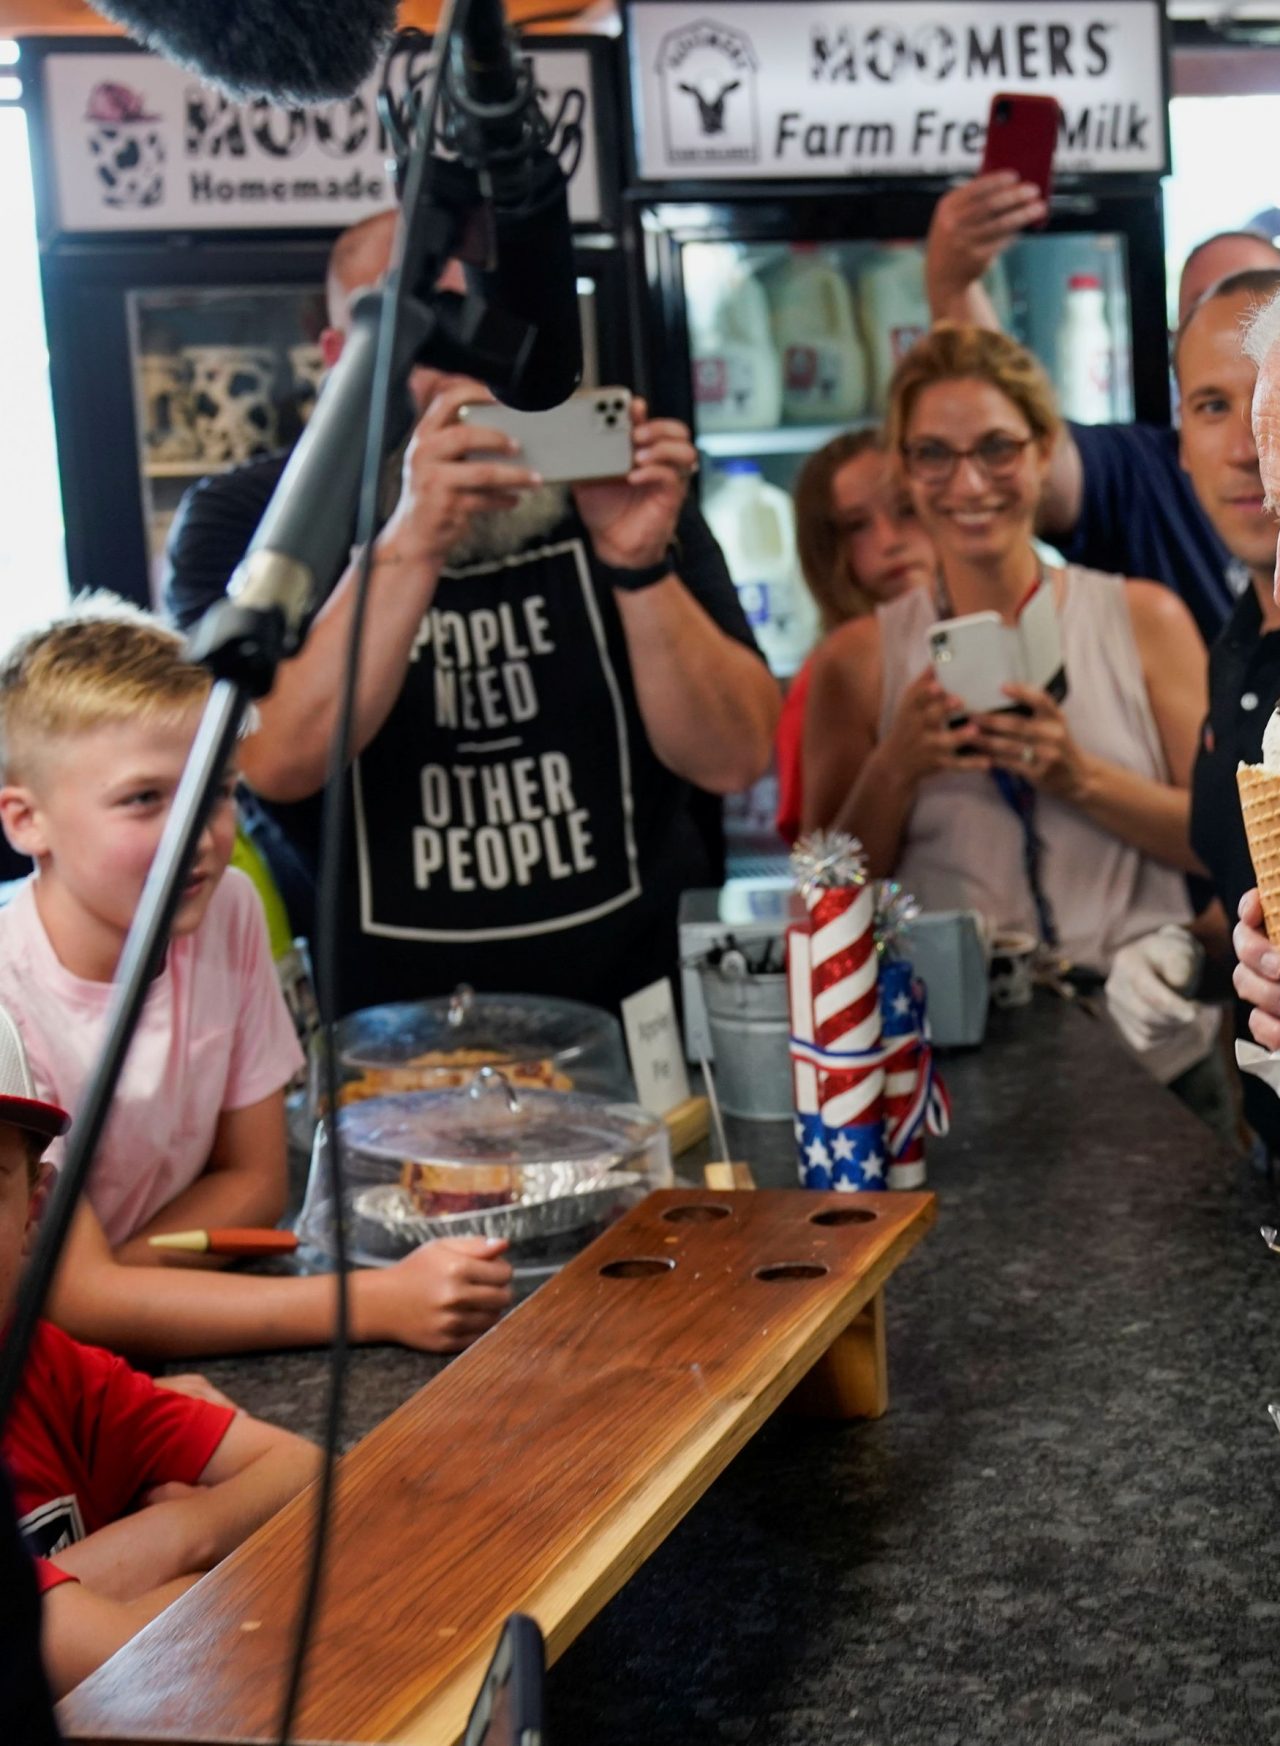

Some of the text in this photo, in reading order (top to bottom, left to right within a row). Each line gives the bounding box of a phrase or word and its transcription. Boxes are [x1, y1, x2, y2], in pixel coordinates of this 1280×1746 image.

[809, 21, 1111, 85] MOOMERS
[774, 101, 1150, 158] Farm Fre Milk
[189, 169, 383, 204] Homemade
[433, 659, 540, 731] NEED
[419, 750, 577, 829] OTHER
[411, 808, 597, 893] PEOPLE
